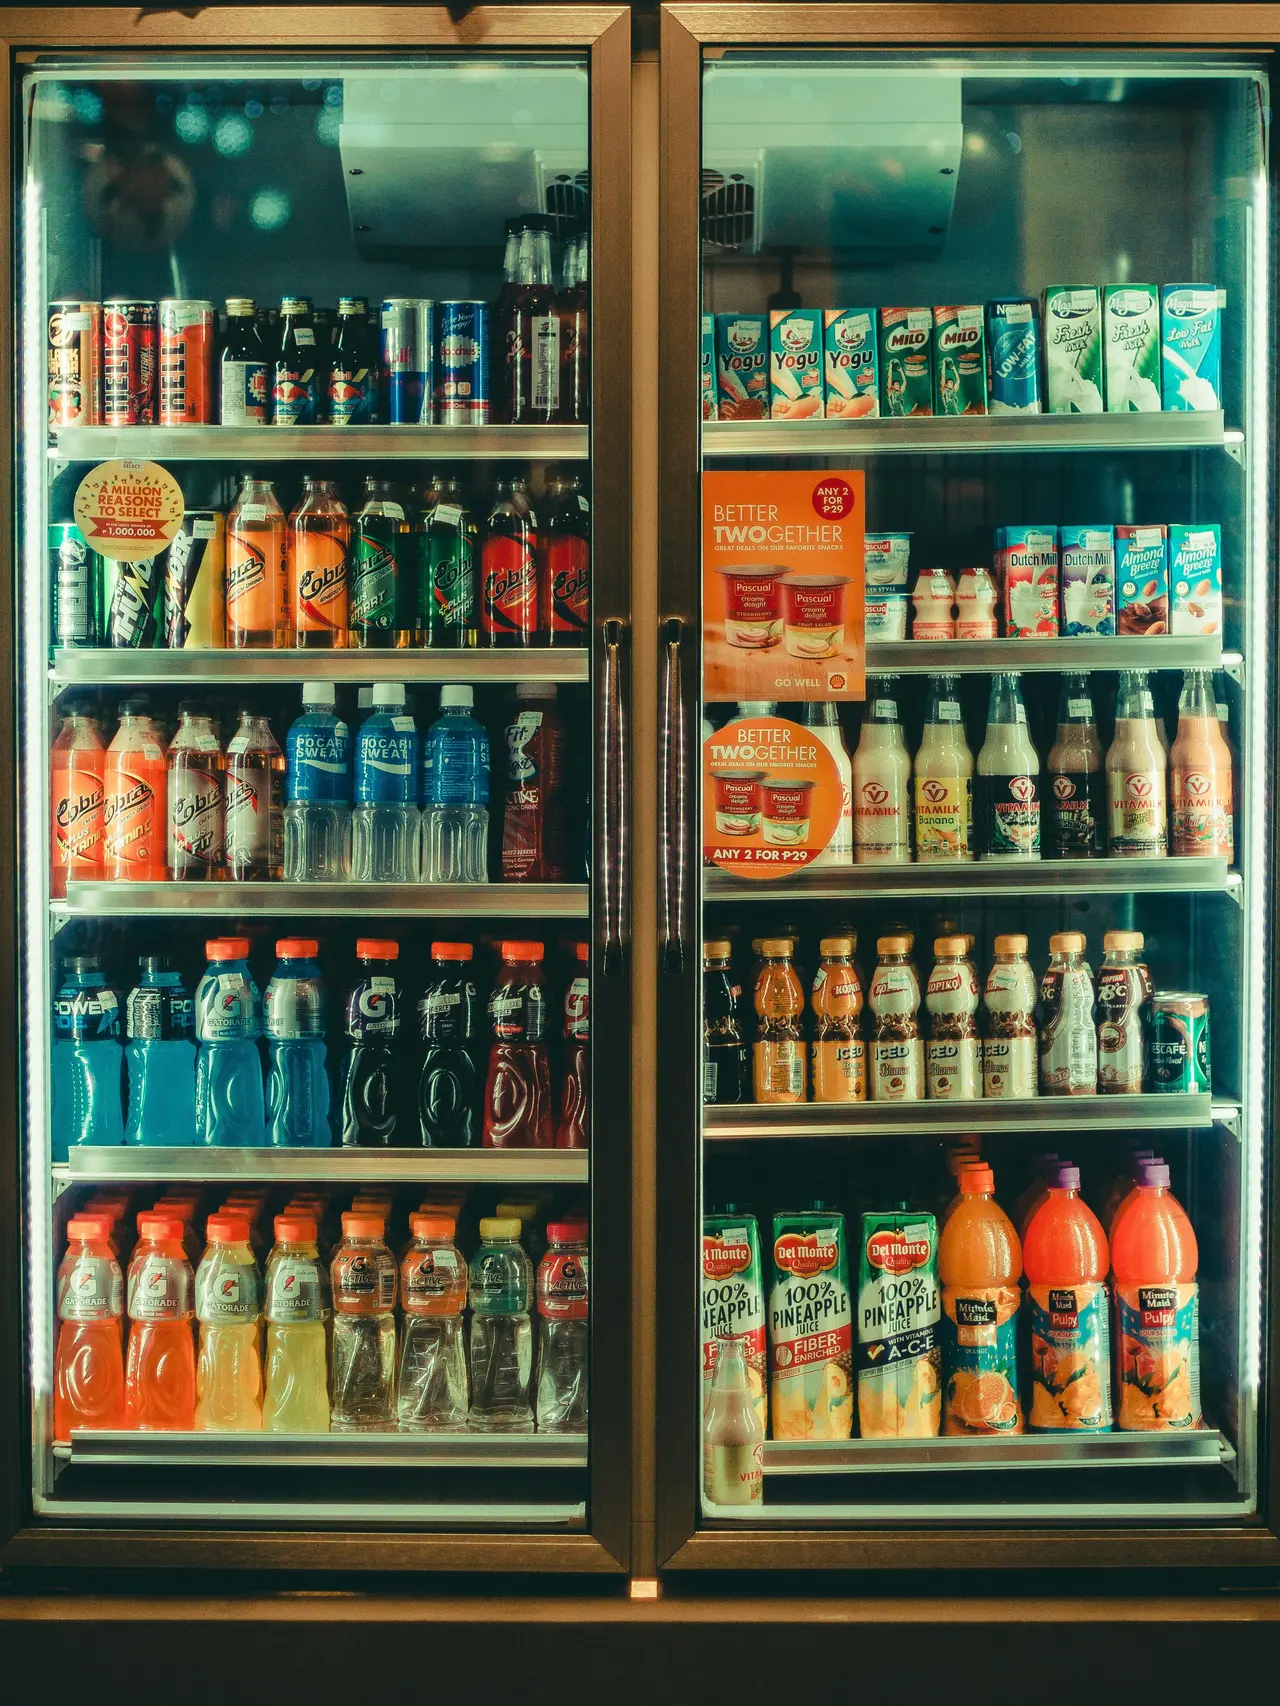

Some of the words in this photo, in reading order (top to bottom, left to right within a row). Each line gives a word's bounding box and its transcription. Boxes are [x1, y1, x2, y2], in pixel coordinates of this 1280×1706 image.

[944, 331, 978, 345] MILO
[1053, 321, 1092, 344] Fresh
[1112, 319, 1149, 343] Fresh
[1167, 328, 1190, 342] Low
[1190, 320, 1214, 337] Fat
[891, 332, 925, 347] MILO
[1065, 340, 1087, 353] Milk
[1123, 338, 1145, 351] Milk
[1180, 338, 1201, 350] Milk
[775, 351, 818, 371] Yogu
[829, 350, 873, 370] Yogu
[996, 330, 1036, 378] LOW-FAT
[722, 353, 765, 373] Yogu
[105, 343, 129, 413] HELL
[160, 342, 187, 413] HELL
[100, 485, 108, 494] A
[111, 485, 162, 496] MILLION
[817, 487, 838, 496] ANY
[842, 487, 849, 496] 2
[98, 495, 163, 507] REASONS
[823, 496, 843, 504] FOR
[99, 506, 115, 516] TO
[118, 507, 161, 518] SELECT
[714, 504, 778, 522] BETTER
[713, 525, 842, 543] TWOGETHER
[865, 542, 889, 550] ascual
[1011, 553, 1039, 567] Dutch
[1041, 553, 1057, 566] Mill
[1065, 553, 1093, 567] Dutch
[1095, 552, 1112, 566] Mill
[1121, 544, 1164, 569] Almond
[1174, 542, 1216, 567] Almond
[1130, 558, 1160, 577] Breeze
[1183, 557, 1213, 576] Breeze
[736, 583, 771, 592] Pascual
[448, 590, 468, 610] PLUS
[743, 601, 766, 609] delight
[797, 593, 832, 603] Pascual
[350, 592, 386, 625] SMART
[804, 611, 827, 620] delight
[775, 679, 792, 687] GO
[795, 679, 820, 687] WELL
[737, 728, 791, 743] BETTER
[296, 738, 347, 748] POCARI
[361, 738, 412, 749] POCARI
[296, 747, 344, 758] SWEAT
[361, 748, 408, 759] SWEAT
[710, 745, 817, 760] TWOGETHER
[725, 784, 753, 792] Pascual
[773, 793, 800, 802] Pascual
[1113, 800, 1163, 809] VITAMILK
[172, 786, 220, 827] Cobra
[919, 815, 955, 825] Banana
[191, 831, 214, 855] FIT
[713, 849, 740, 859] ANY
[744, 849, 752, 859] 2
[755, 850, 780, 860] FOR
[207, 1018, 251, 1027] GATORADE
[836, 1045, 863, 1060] ICED
[876, 1045, 909, 1060] ICED
[928, 1045, 958, 1060] ICED
[711, 1248, 747, 1260] Monte
[778, 1247, 795, 1259] Del
[798, 1246, 834, 1258] Monte
[872, 1245, 889, 1256] Del
[891, 1243, 927, 1256] Monte
[706, 1261, 732, 1271] Quality
[792, 1259, 819, 1269] Quality
[885, 1256, 911, 1267] Quality
[70, 1265, 97, 1298] G
[140, 1265, 168, 1298] G
[342, 1273, 374, 1284] ACTIVE
[411, 1276, 445, 1286] ACTIVE
[552, 1280, 587, 1291] ACTIVE
[213, 1272, 240, 1303] G
[784, 1281, 836, 1307] 100%
[877, 1278, 927, 1304] 100%
[65, 1297, 107, 1306] GATORADE
[134, 1297, 178, 1307] GATORADE
[1052, 1293, 1074, 1301] Minute
[1142, 1290, 1175, 1300] Minute
[206, 1302, 249, 1312] GATORADE
[270, 1299, 311, 1308] GATORADE
[864, 1289, 937, 1329] PINEAPPLE
[959, 1302, 994, 1313] Minute
[1055, 1301, 1072, 1309] Maid
[1146, 1299, 1171, 1308] Maid
[773, 1293, 847, 1331] PINEAPPLE
[963, 1312, 989, 1323] Maid
[1144, 1312, 1175, 1326] Pulpy
[888, 1319, 911, 1334] JUICE
[1052, 1313, 1078, 1327] Pulpy
[710, 1322, 733, 1338] JUICE
[795, 1321, 819, 1336] JUICE
[888, 1336, 904, 1345] WITH
[905, 1328, 934, 1341] VITAMINS
[794, 1333, 842, 1355] FIBER-
[888, 1335, 934, 1361] A-C-E
[794, 1345, 841, 1364] ENRICHED
